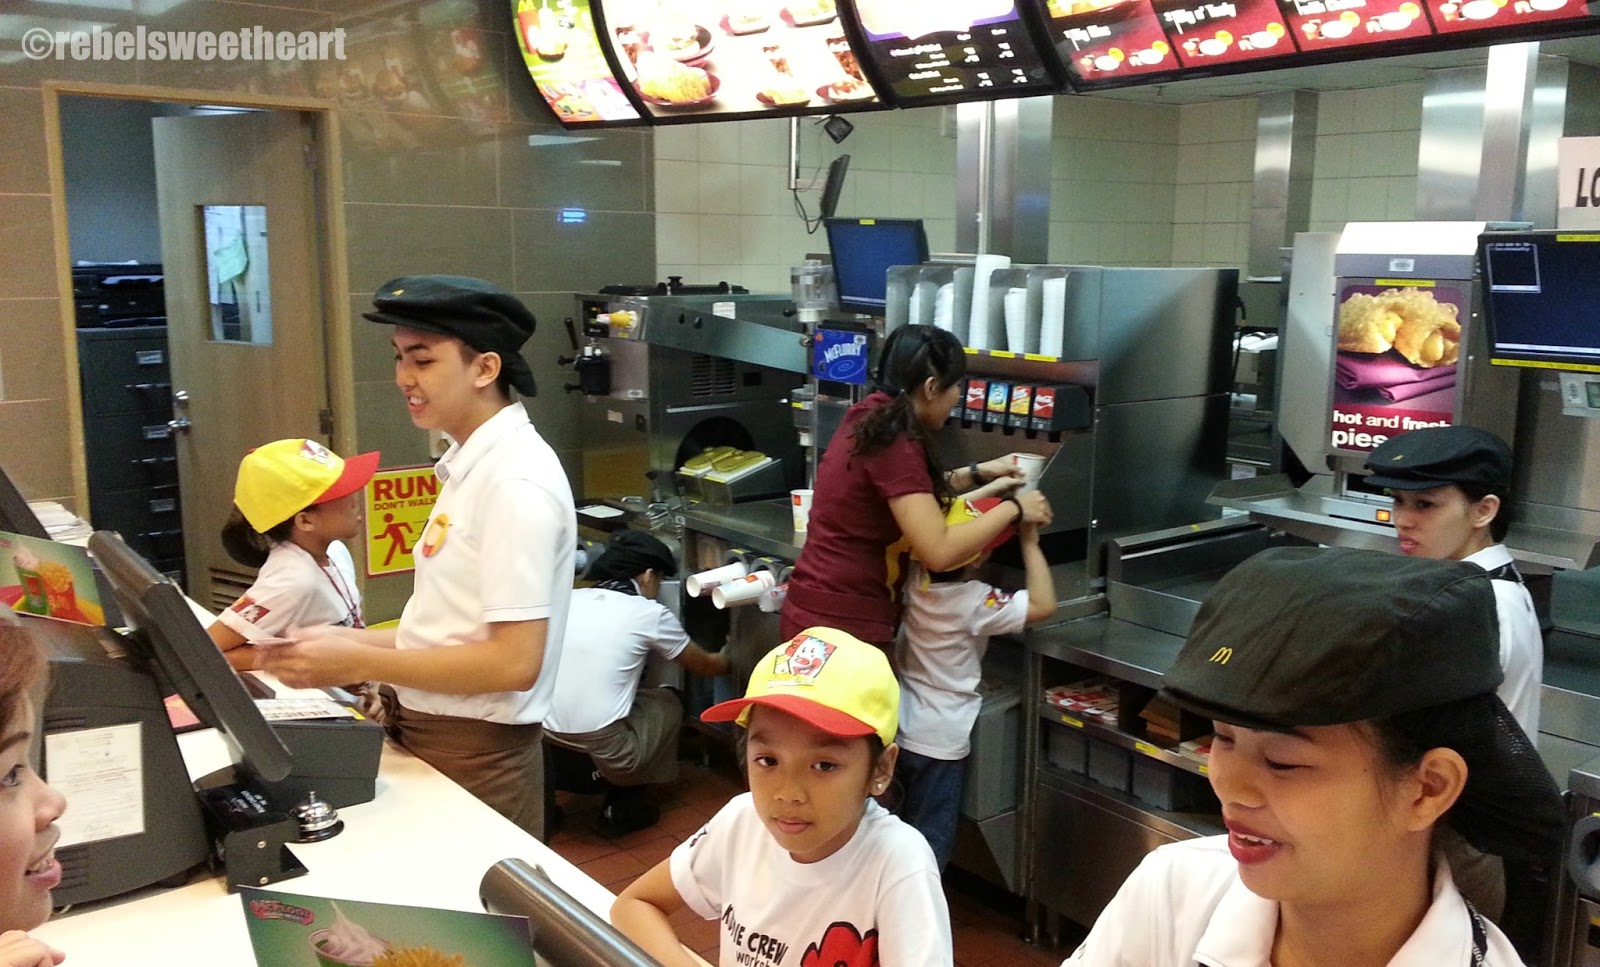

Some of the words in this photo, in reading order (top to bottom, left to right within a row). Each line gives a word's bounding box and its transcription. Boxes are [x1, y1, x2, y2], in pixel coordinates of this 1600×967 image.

[1333, 410, 1363, 425] hot
[1366, 415, 1399, 428] and
[1332, 428, 1389, 448] pies
[373, 475, 437, 501] RUN
[374, 500, 404, 511] DON'T
[747, 932, 789, 966] CREW
